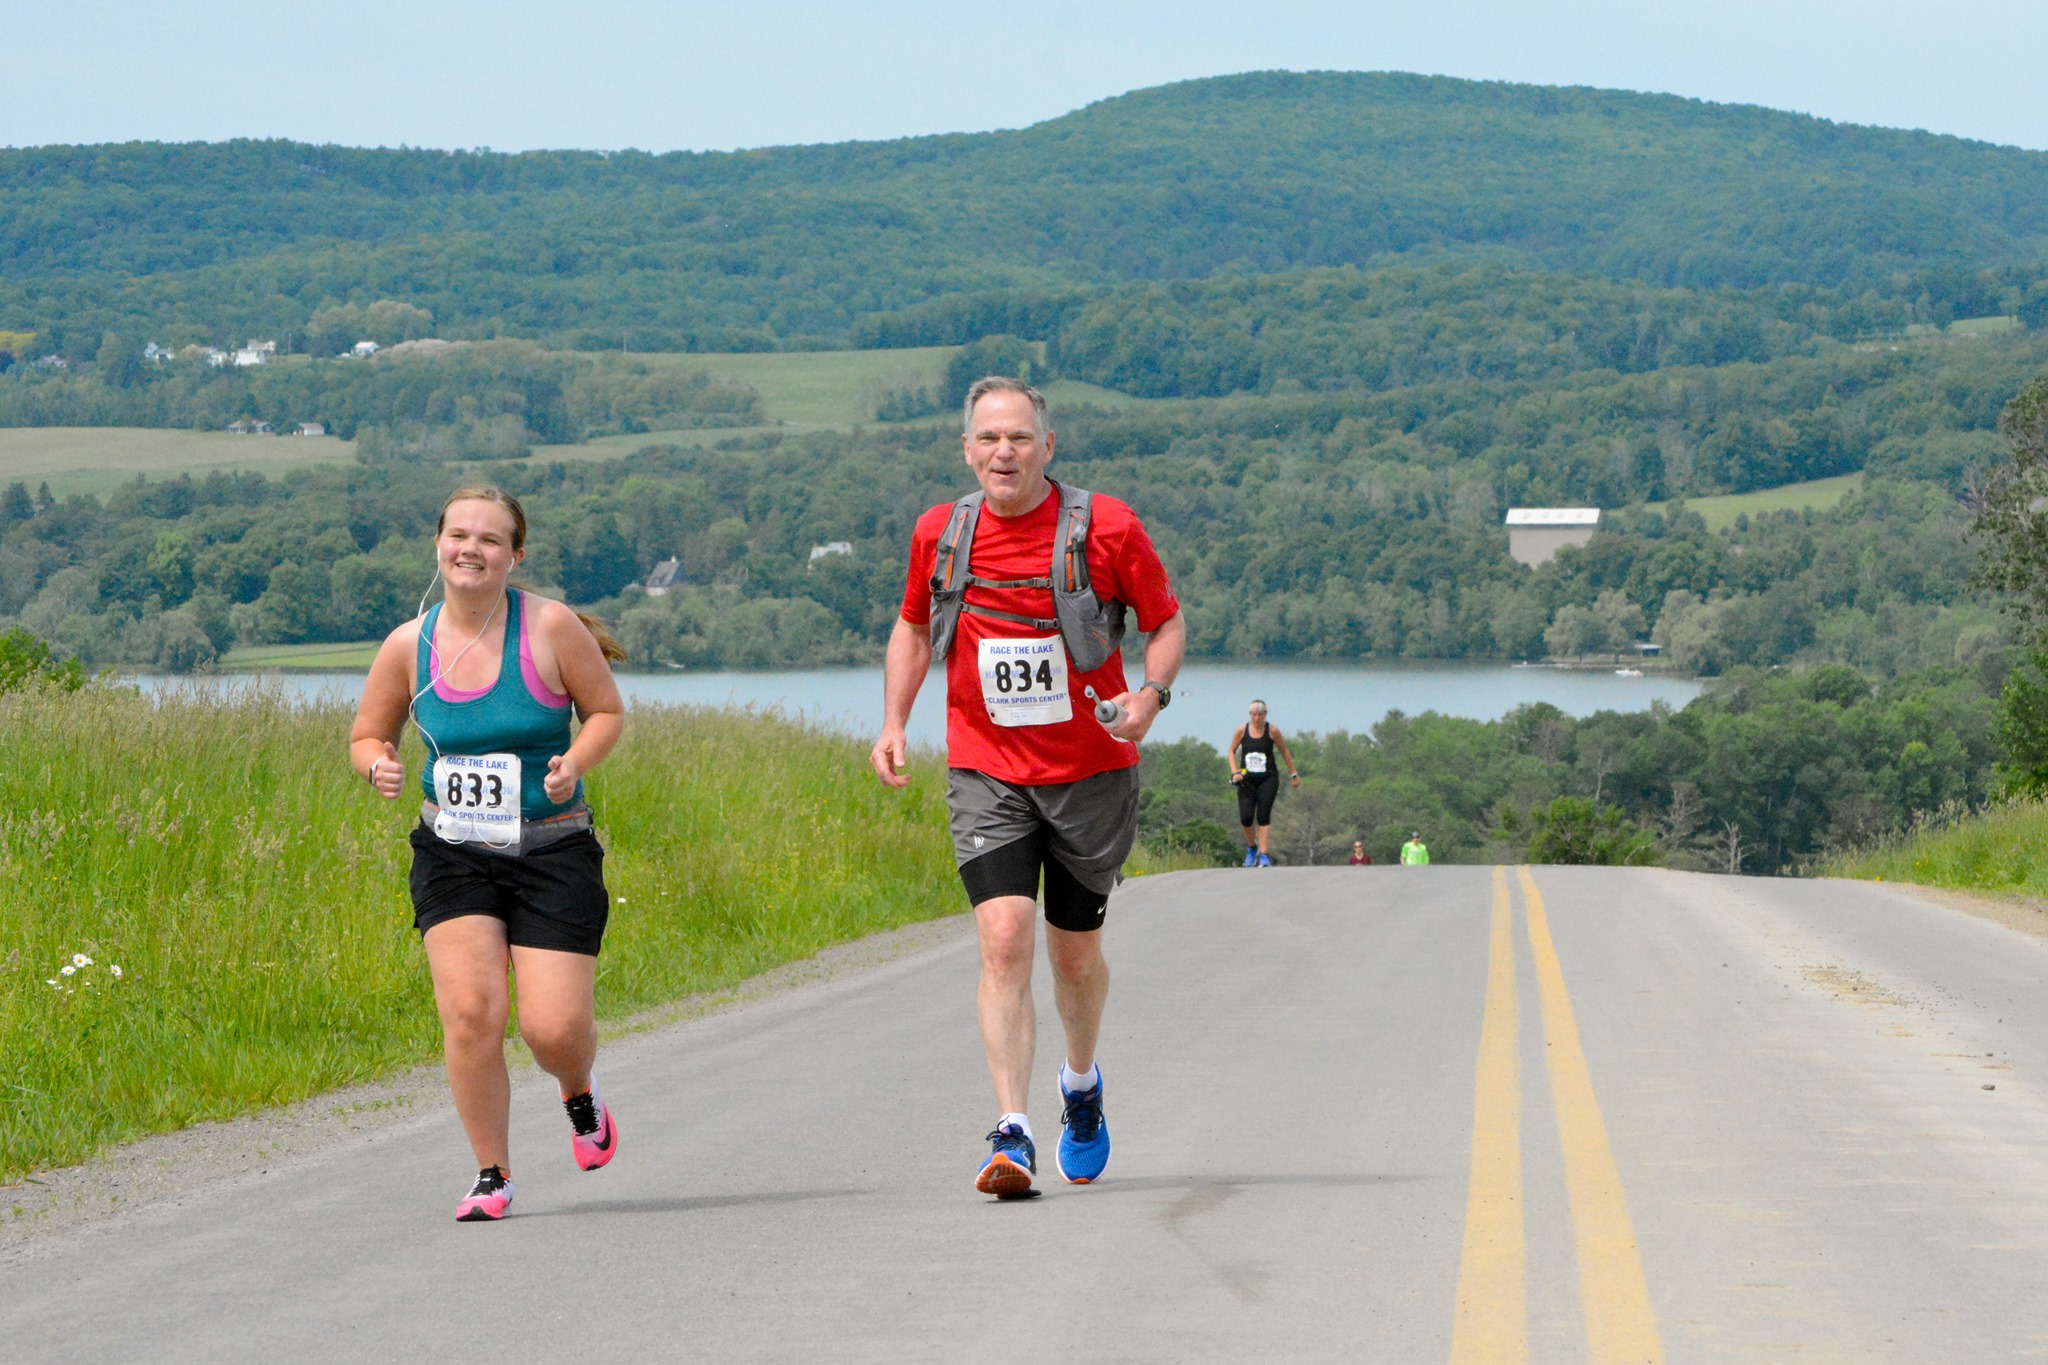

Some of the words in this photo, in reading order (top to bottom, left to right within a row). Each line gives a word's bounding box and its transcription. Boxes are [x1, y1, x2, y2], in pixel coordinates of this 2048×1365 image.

[990, 646, 1011, 655] RACE
[1013, 646, 1030, 655] THE
[1032, 644, 1054, 654] LAKE
[995, 659, 1053, 693] 834
[988, 696, 1009, 704] CLARK
[1039, 693, 1064, 702] CENTER
[446, 756, 466, 766] RACE
[469, 758, 484, 768] THE
[486, 760, 508, 770] LAKE
[447, 772, 502, 808] 833
